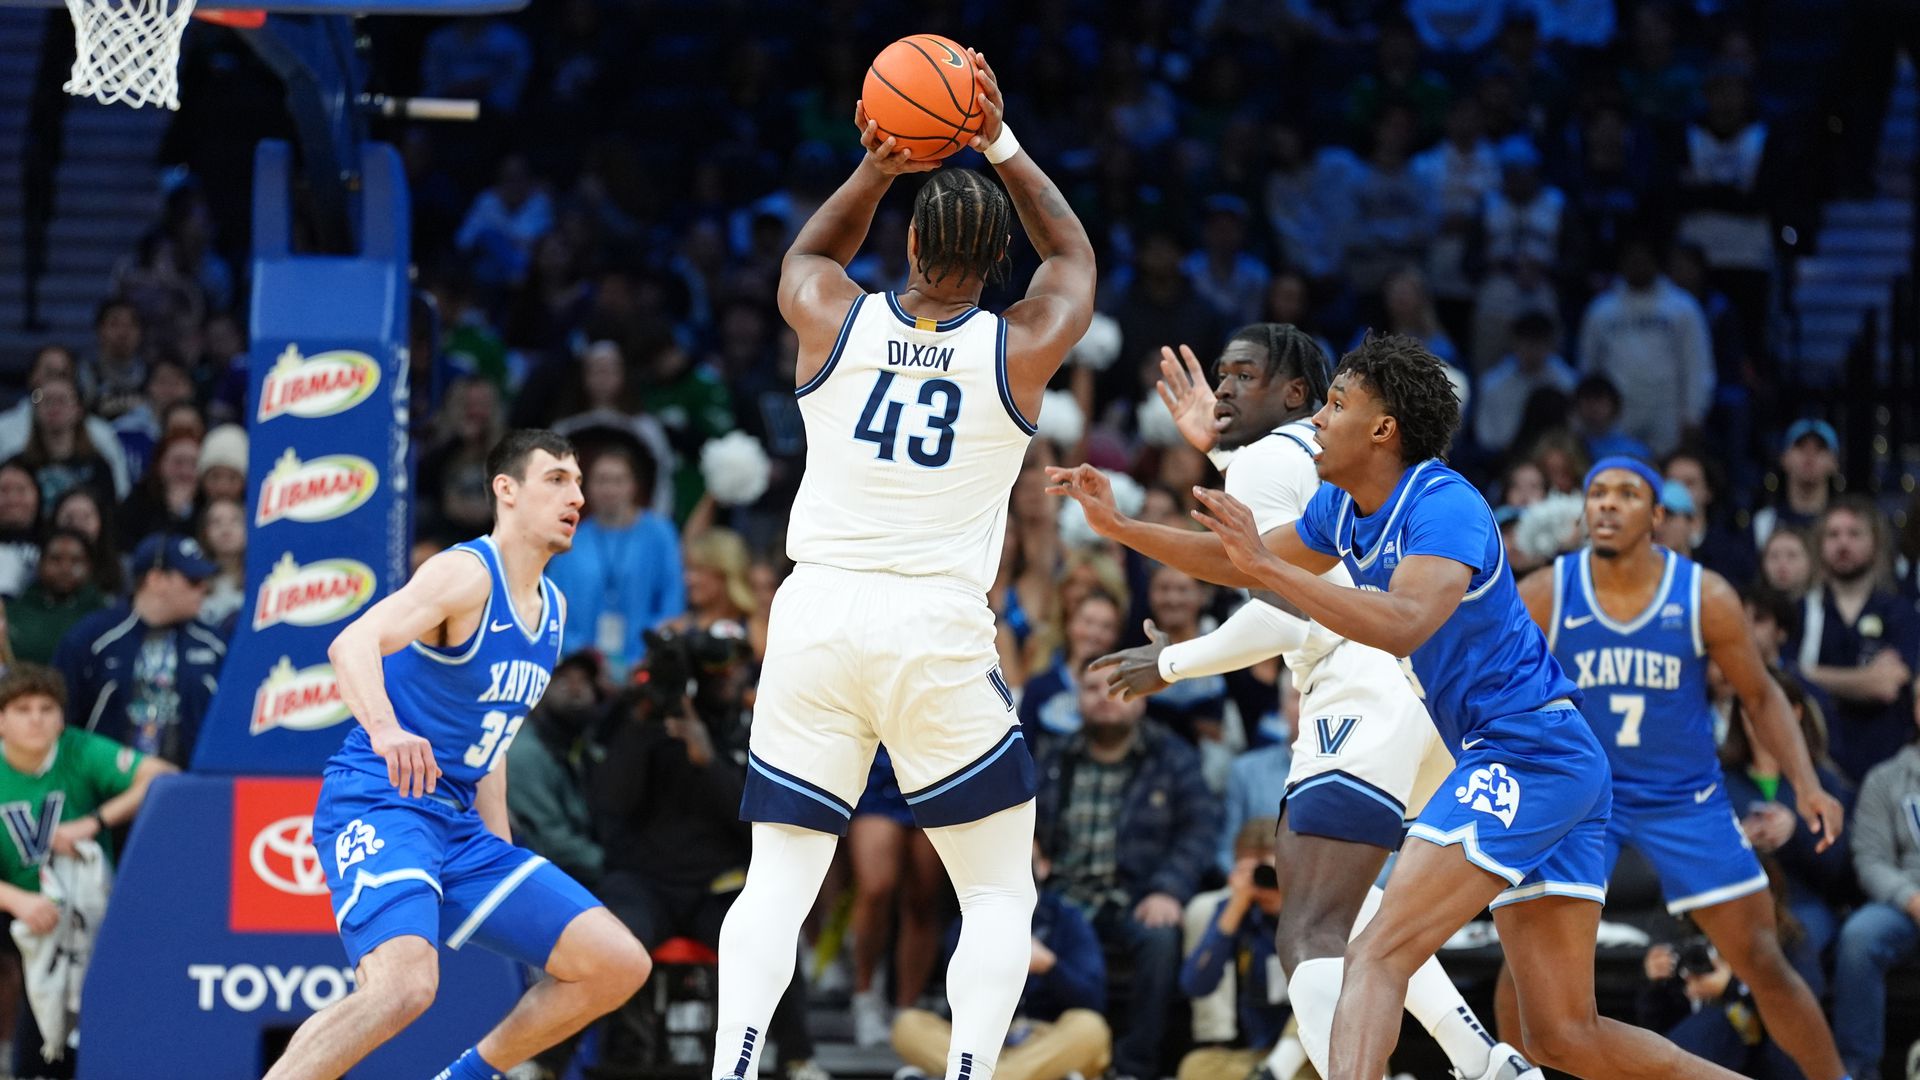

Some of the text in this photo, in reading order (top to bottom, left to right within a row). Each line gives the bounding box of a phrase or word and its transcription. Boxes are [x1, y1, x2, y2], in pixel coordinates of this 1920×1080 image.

[888, 340, 955, 372] DIXON
[263, 363, 369, 416] LIBMAN
[853, 368, 964, 469] 43
[261, 467, 366, 519] LIBMAN
[259, 573, 364, 621] LIBMAN
[477, 660, 551, 711] XAVIE
[1574, 646, 1681, 690] XAVIER
[255, 682, 342, 725] LIBMA
[1609, 693, 1645, 747] 7
[1313, 715, 1362, 758] V
[0, 790, 65, 867] V
[187, 963, 356, 1013] TOYO
